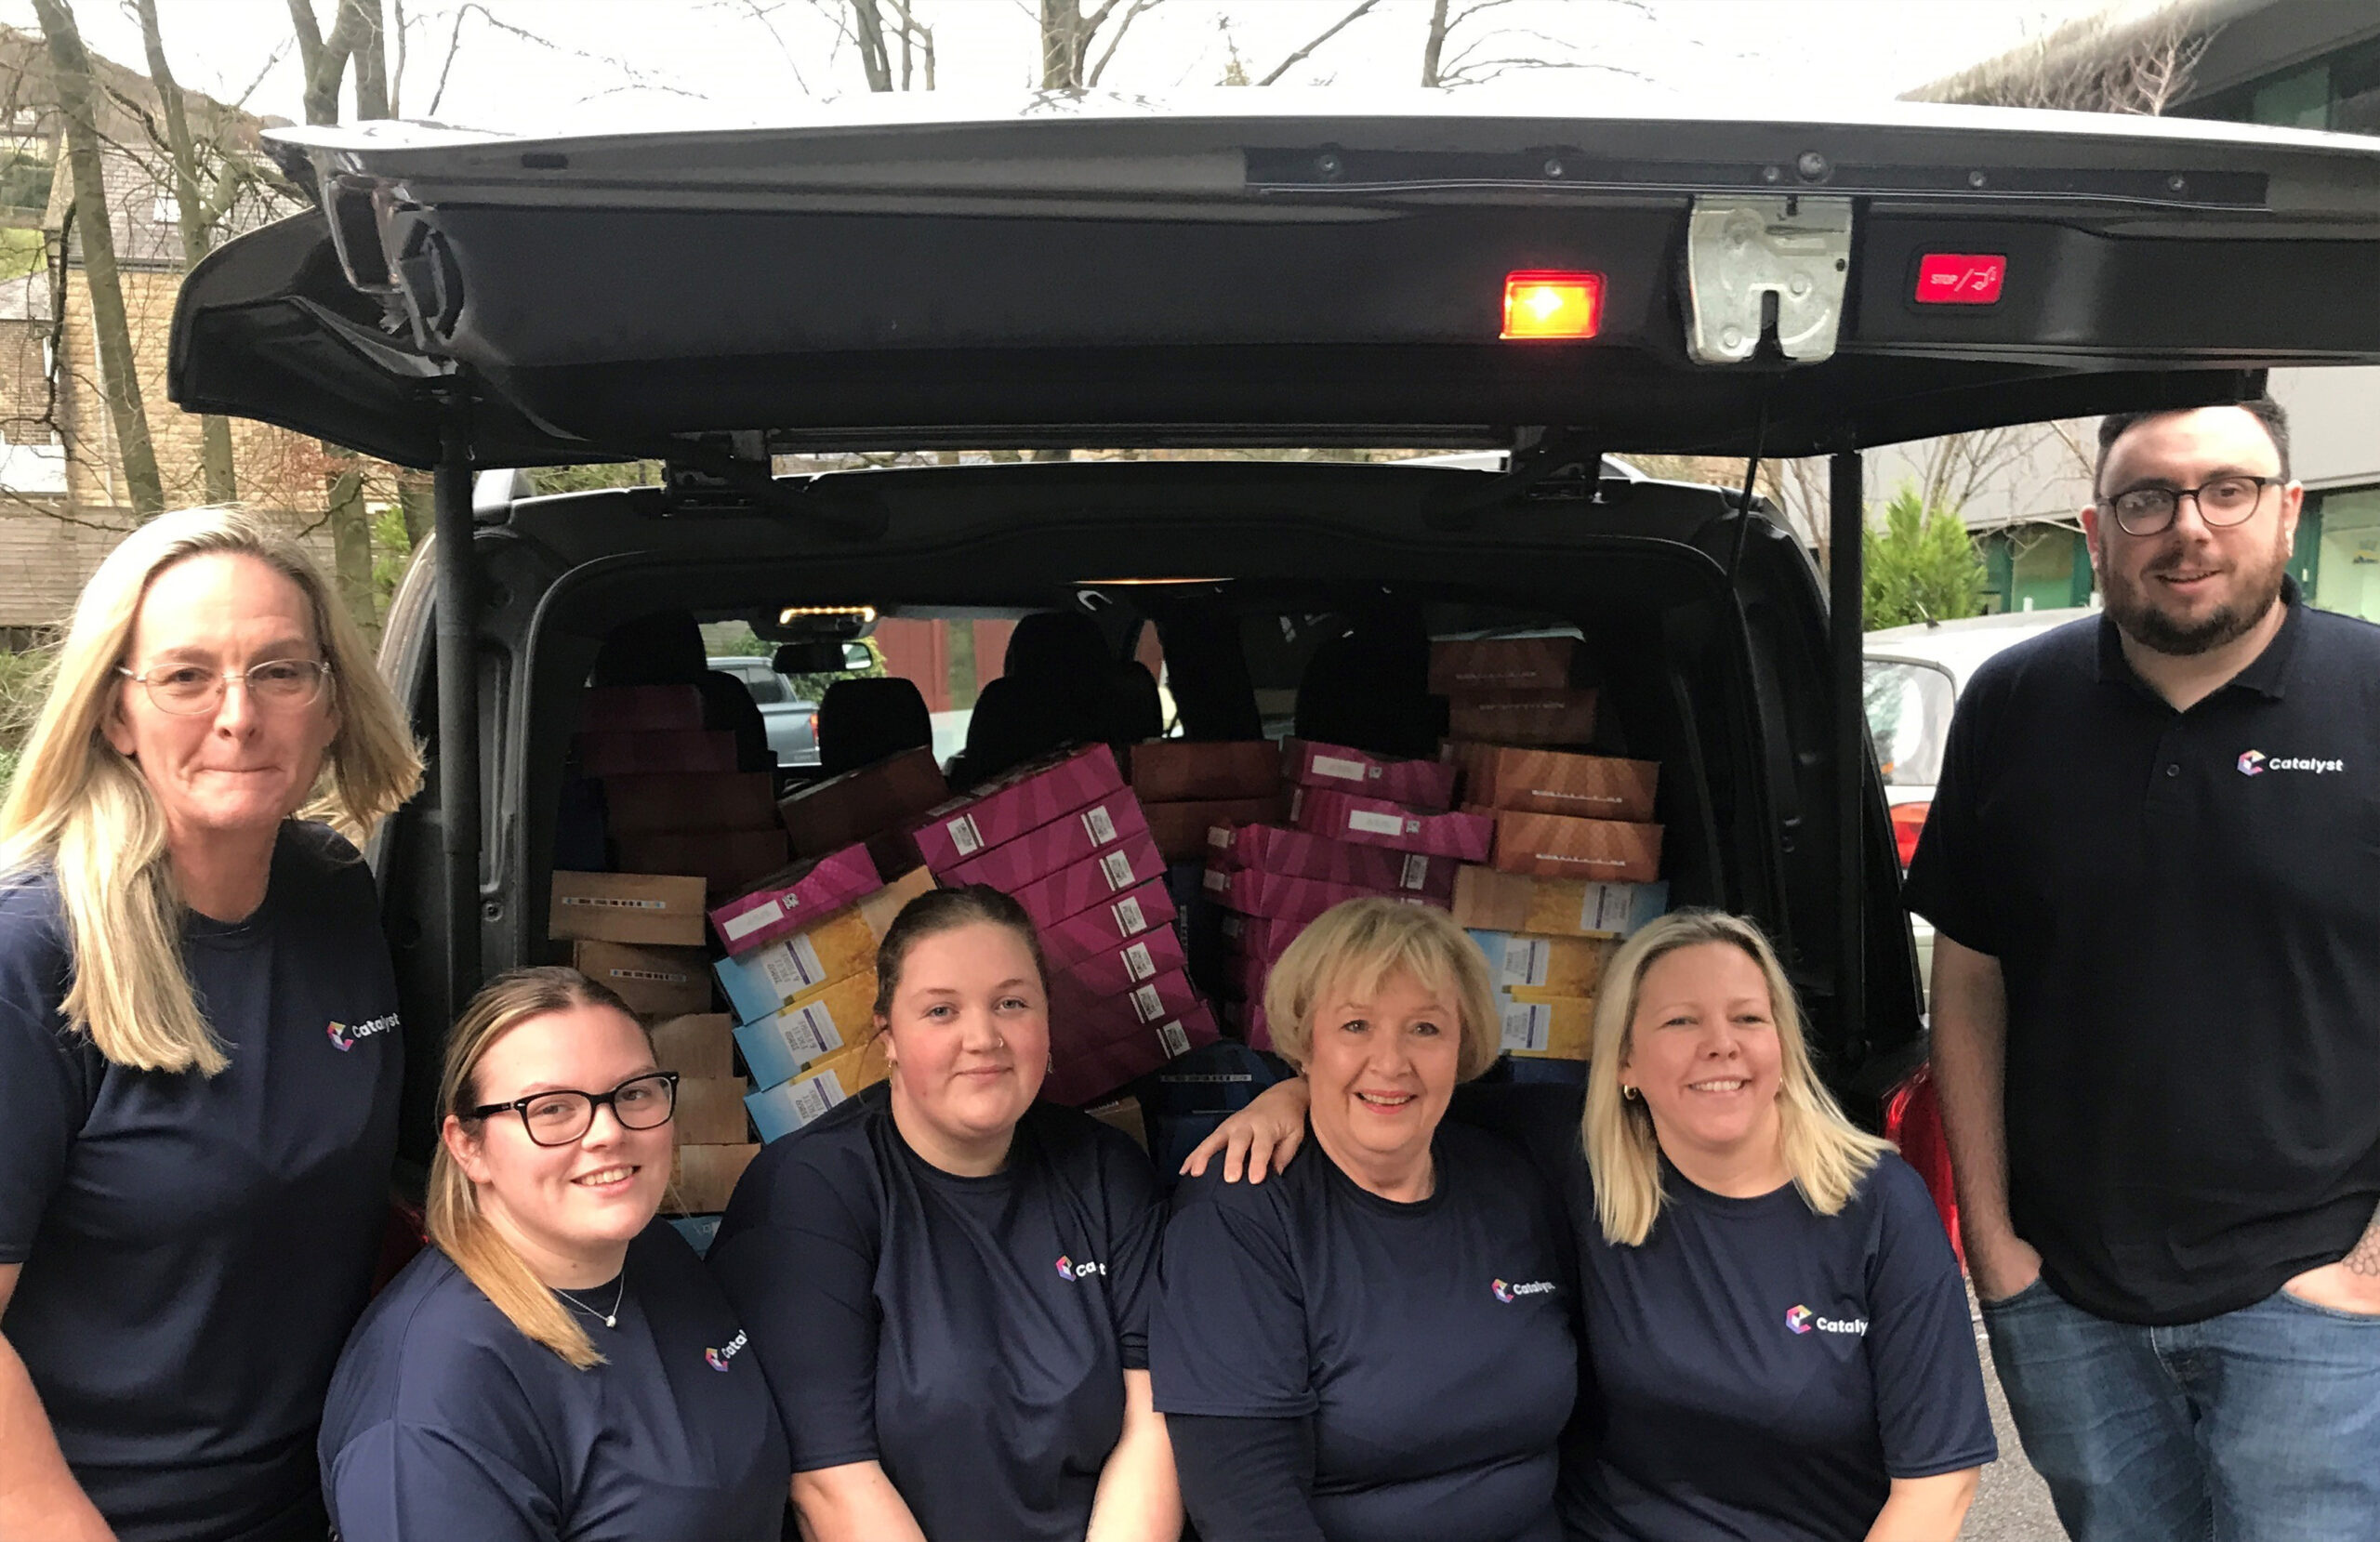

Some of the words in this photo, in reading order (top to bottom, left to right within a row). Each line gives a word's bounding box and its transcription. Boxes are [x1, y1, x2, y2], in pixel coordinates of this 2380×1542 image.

[2268, 757, 2344, 774] Catalyst
[351, 1012, 401, 1038] Catalyst
[1816, 1316, 1869, 1337] Cataly
[721, 1328, 748, 1359] Catal
